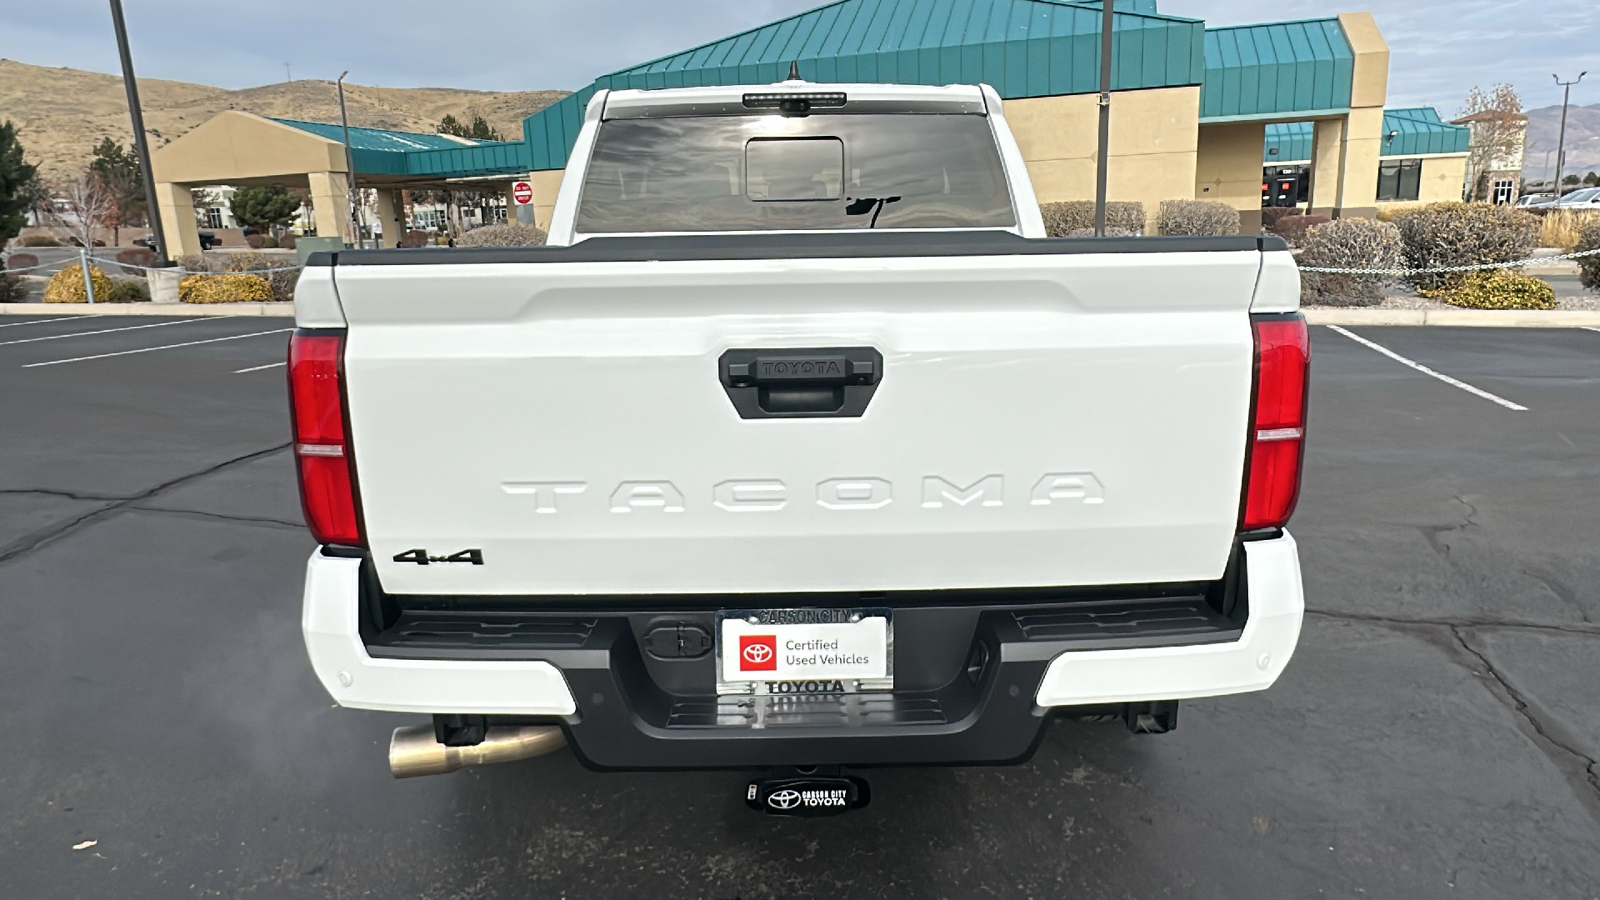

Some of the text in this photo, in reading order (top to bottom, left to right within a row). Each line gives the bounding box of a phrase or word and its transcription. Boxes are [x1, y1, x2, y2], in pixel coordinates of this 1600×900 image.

[762, 362, 840, 375] TOYOTA
[501, 472, 1105, 514] TACOMA
[393, 548, 484, 565] 4x4
[758, 609, 851, 624] CARSON CITY
[785, 639, 838, 651] Certified
[786, 653, 869, 665] Used Vehicles
[765, 680, 845, 694] TOYOTA
[831, 789, 847, 798] CITY
[803, 798, 846, 806] TOYOTA
